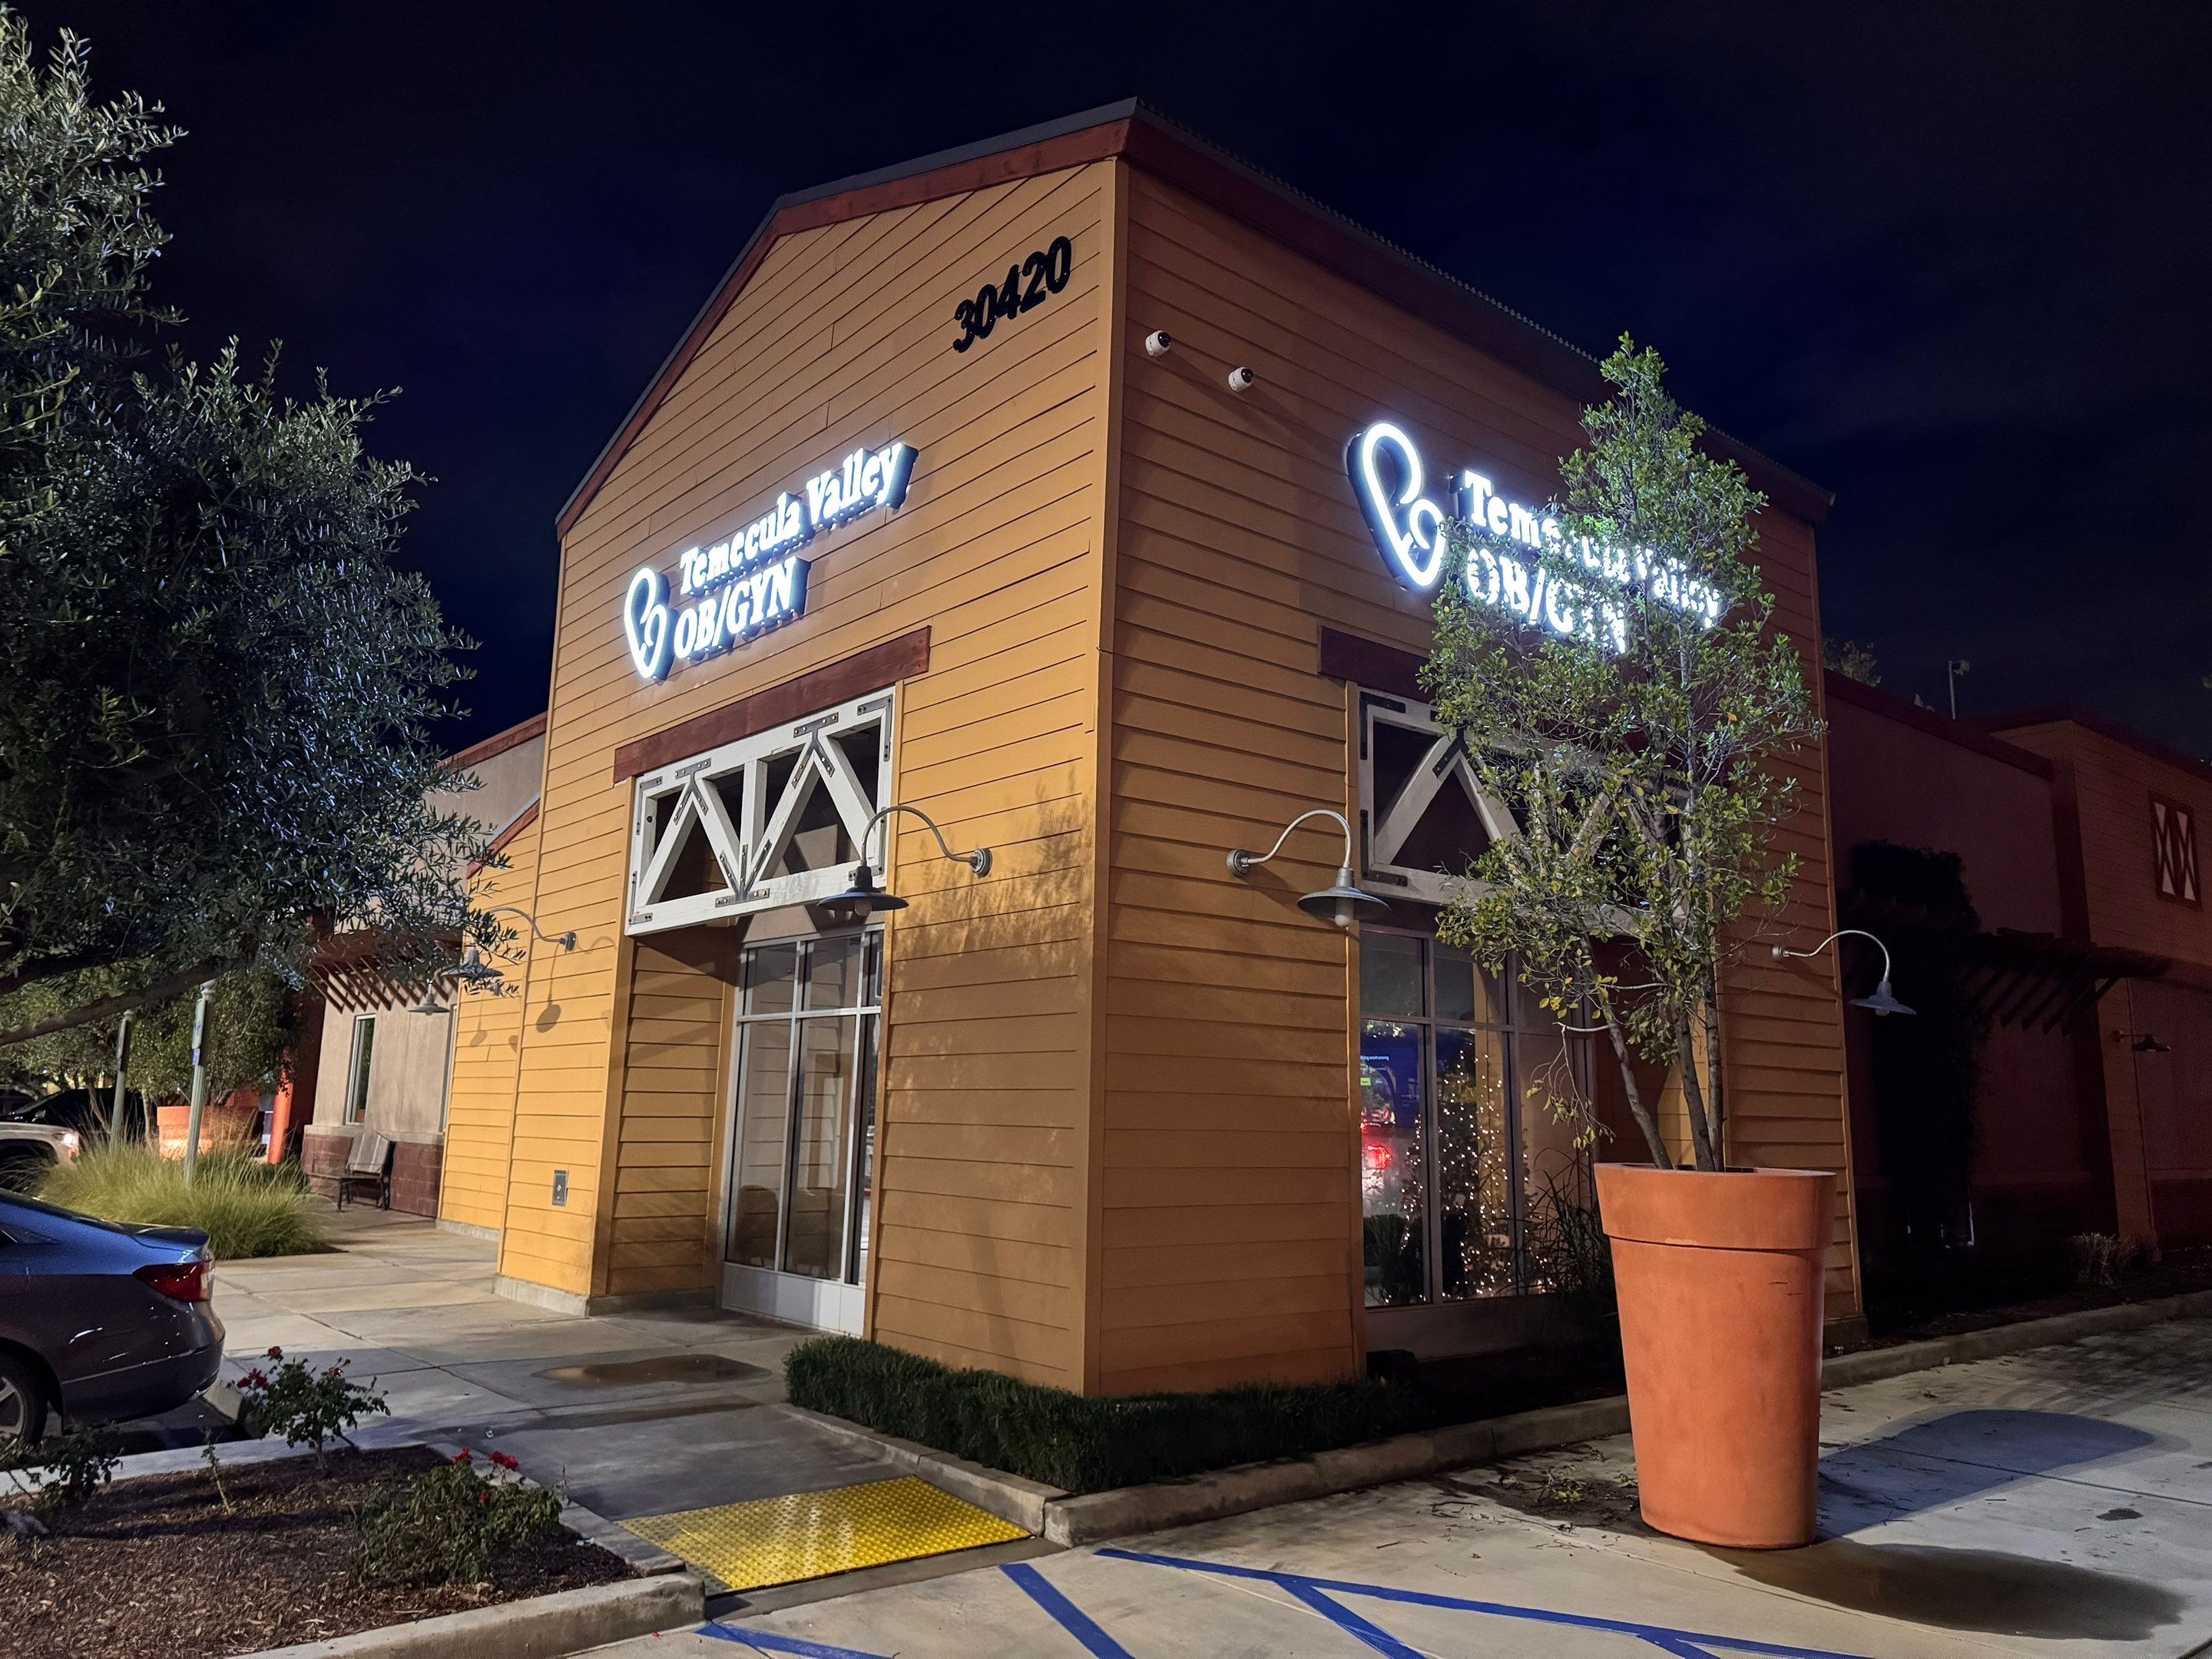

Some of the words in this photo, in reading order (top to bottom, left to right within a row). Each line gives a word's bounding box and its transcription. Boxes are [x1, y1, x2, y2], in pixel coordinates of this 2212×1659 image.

[952, 235, 1072, 353] 30420
[680, 491, 802, 595] Temecula
[806, 442, 903, 525] Valley
[674, 555, 797, 660] OB/GYN
